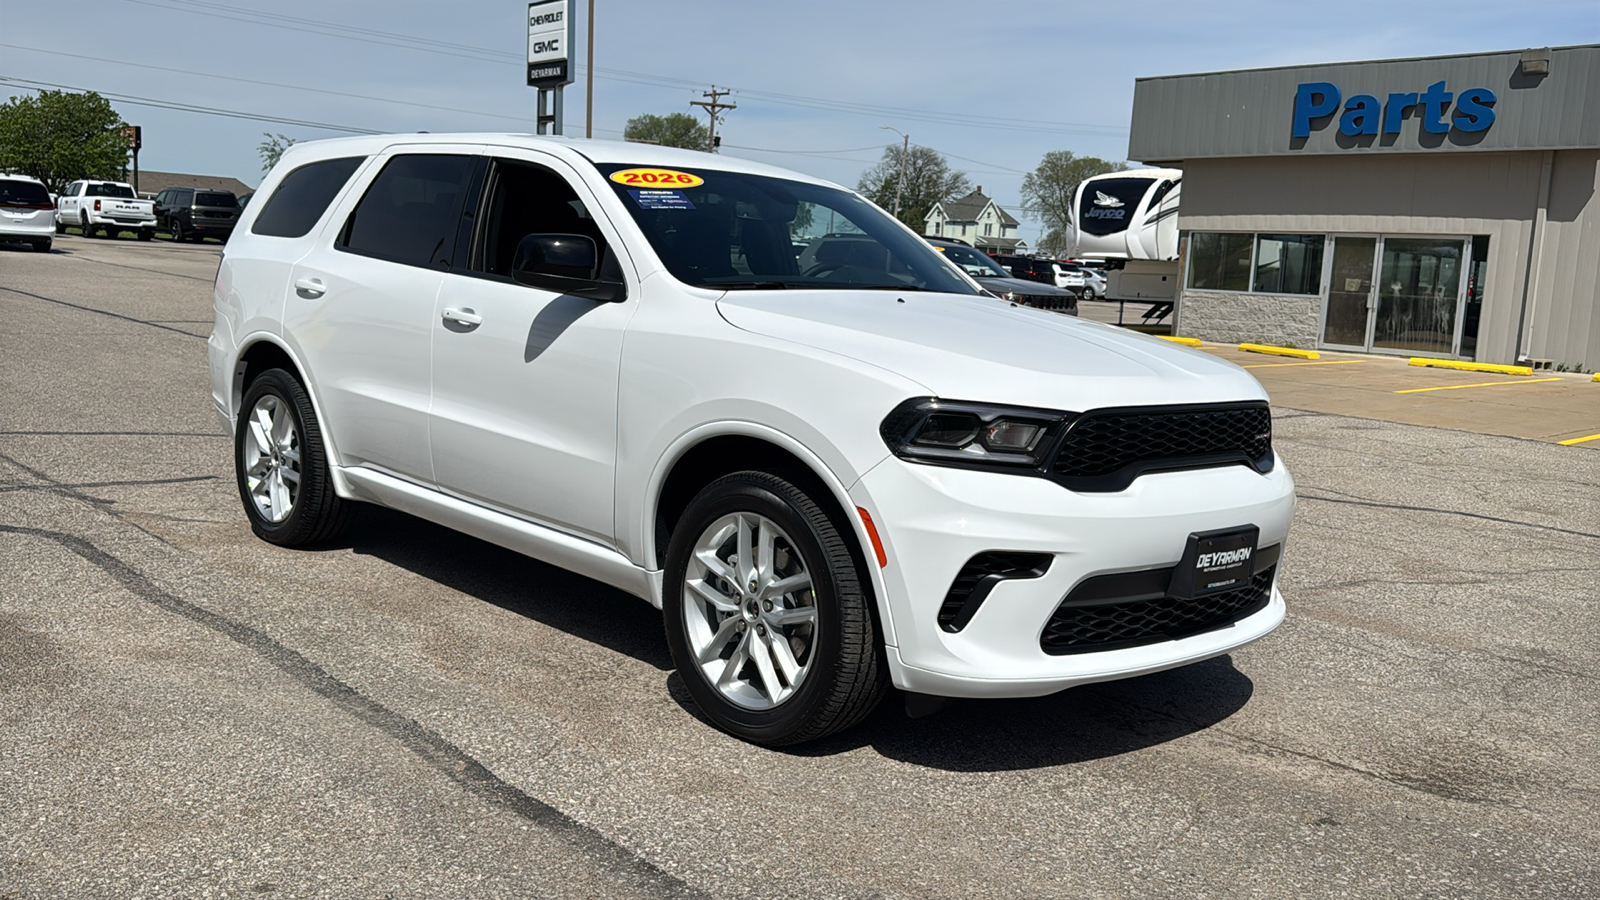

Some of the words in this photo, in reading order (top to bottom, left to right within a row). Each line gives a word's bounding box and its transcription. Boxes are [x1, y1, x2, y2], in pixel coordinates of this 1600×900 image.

[530, 11, 563, 27] CHEVROLET
[533, 39, 559, 54] GMC
[531, 66, 561, 79] DEYARMAN
[1293, 80, 1497, 138] Parts
[623, 173, 694, 184] 2026
[1084, 207, 1126, 219] Jayco
[1196, 546, 1252, 569] DEYARMAN
